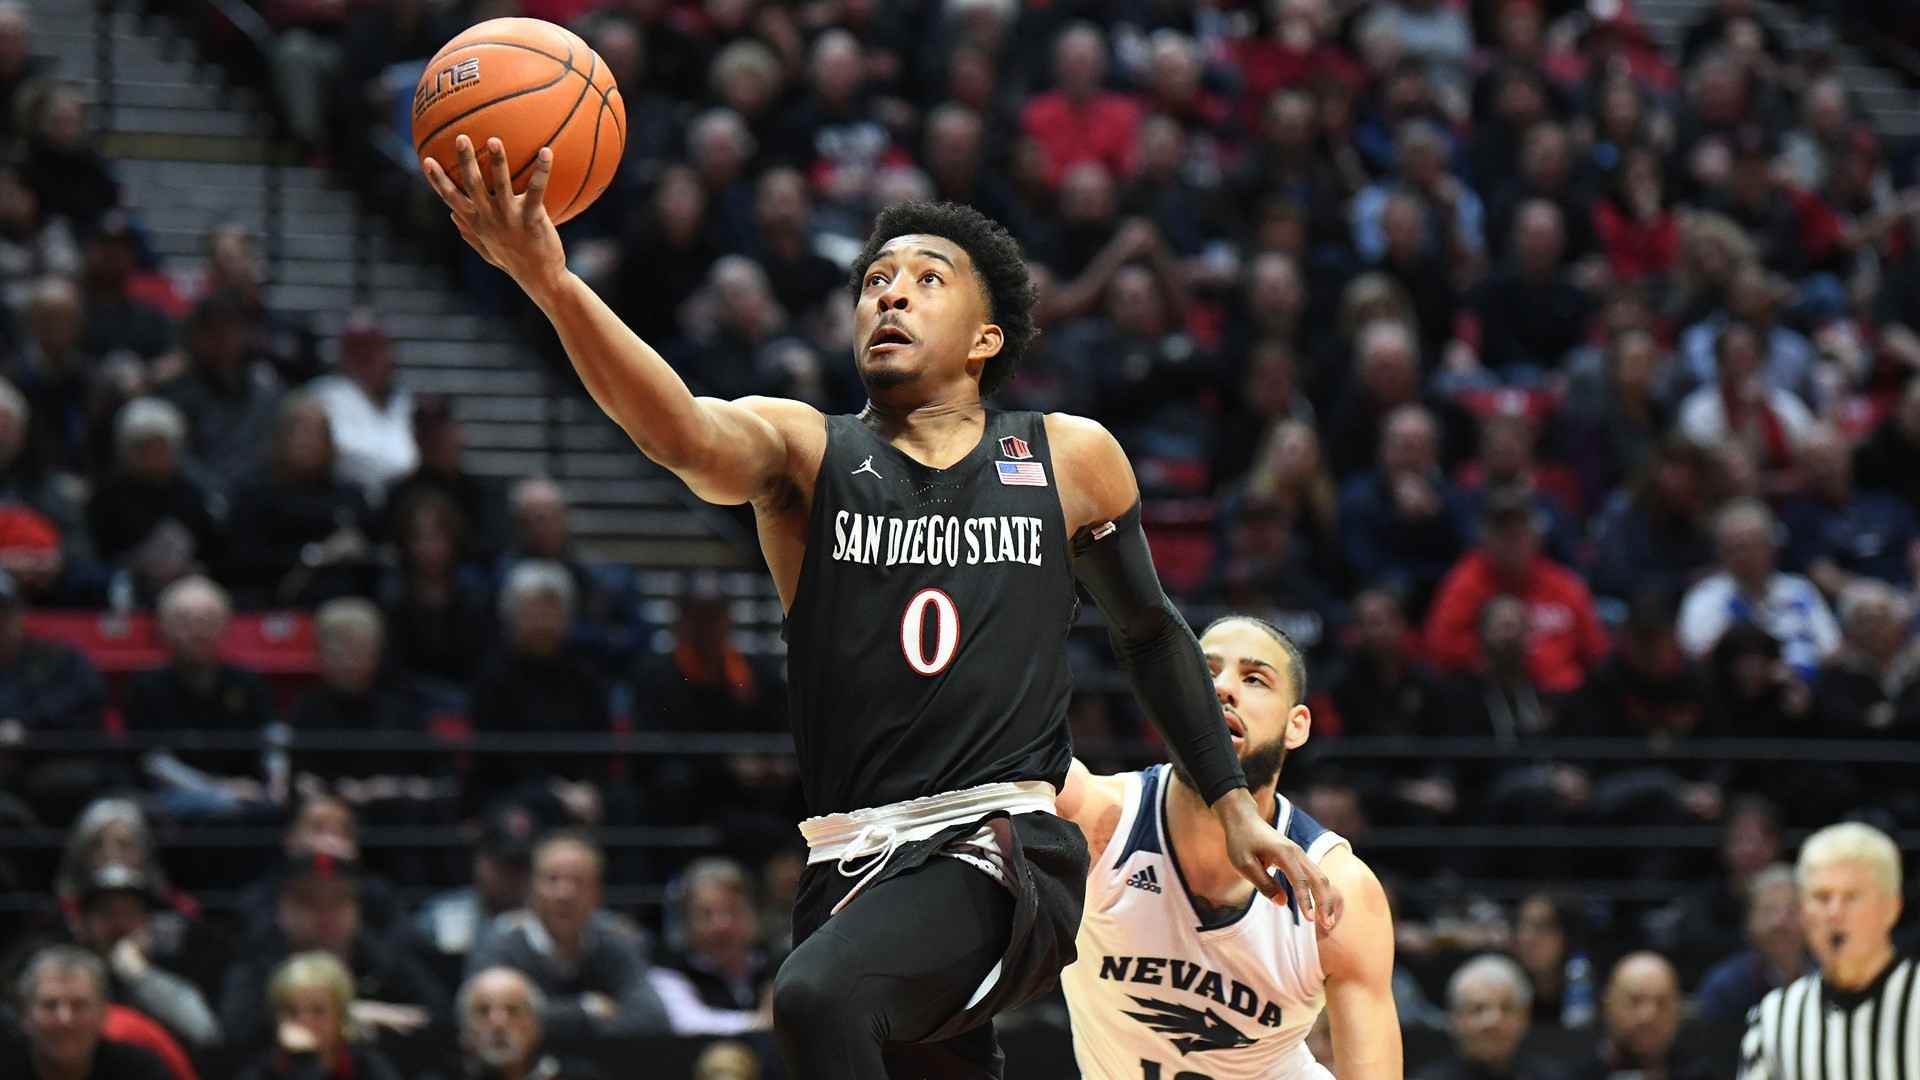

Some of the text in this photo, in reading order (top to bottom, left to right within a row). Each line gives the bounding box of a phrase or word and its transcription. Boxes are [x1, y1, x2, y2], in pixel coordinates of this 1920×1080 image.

[415, 57, 479, 114] ELITE
[832, 510, 1043, 567] SAN DIEGO STATE
[900, 587, 960, 676] 0
[1126, 878, 1162, 895] adidas
[1099, 955, 1282, 1028] NEVADA
